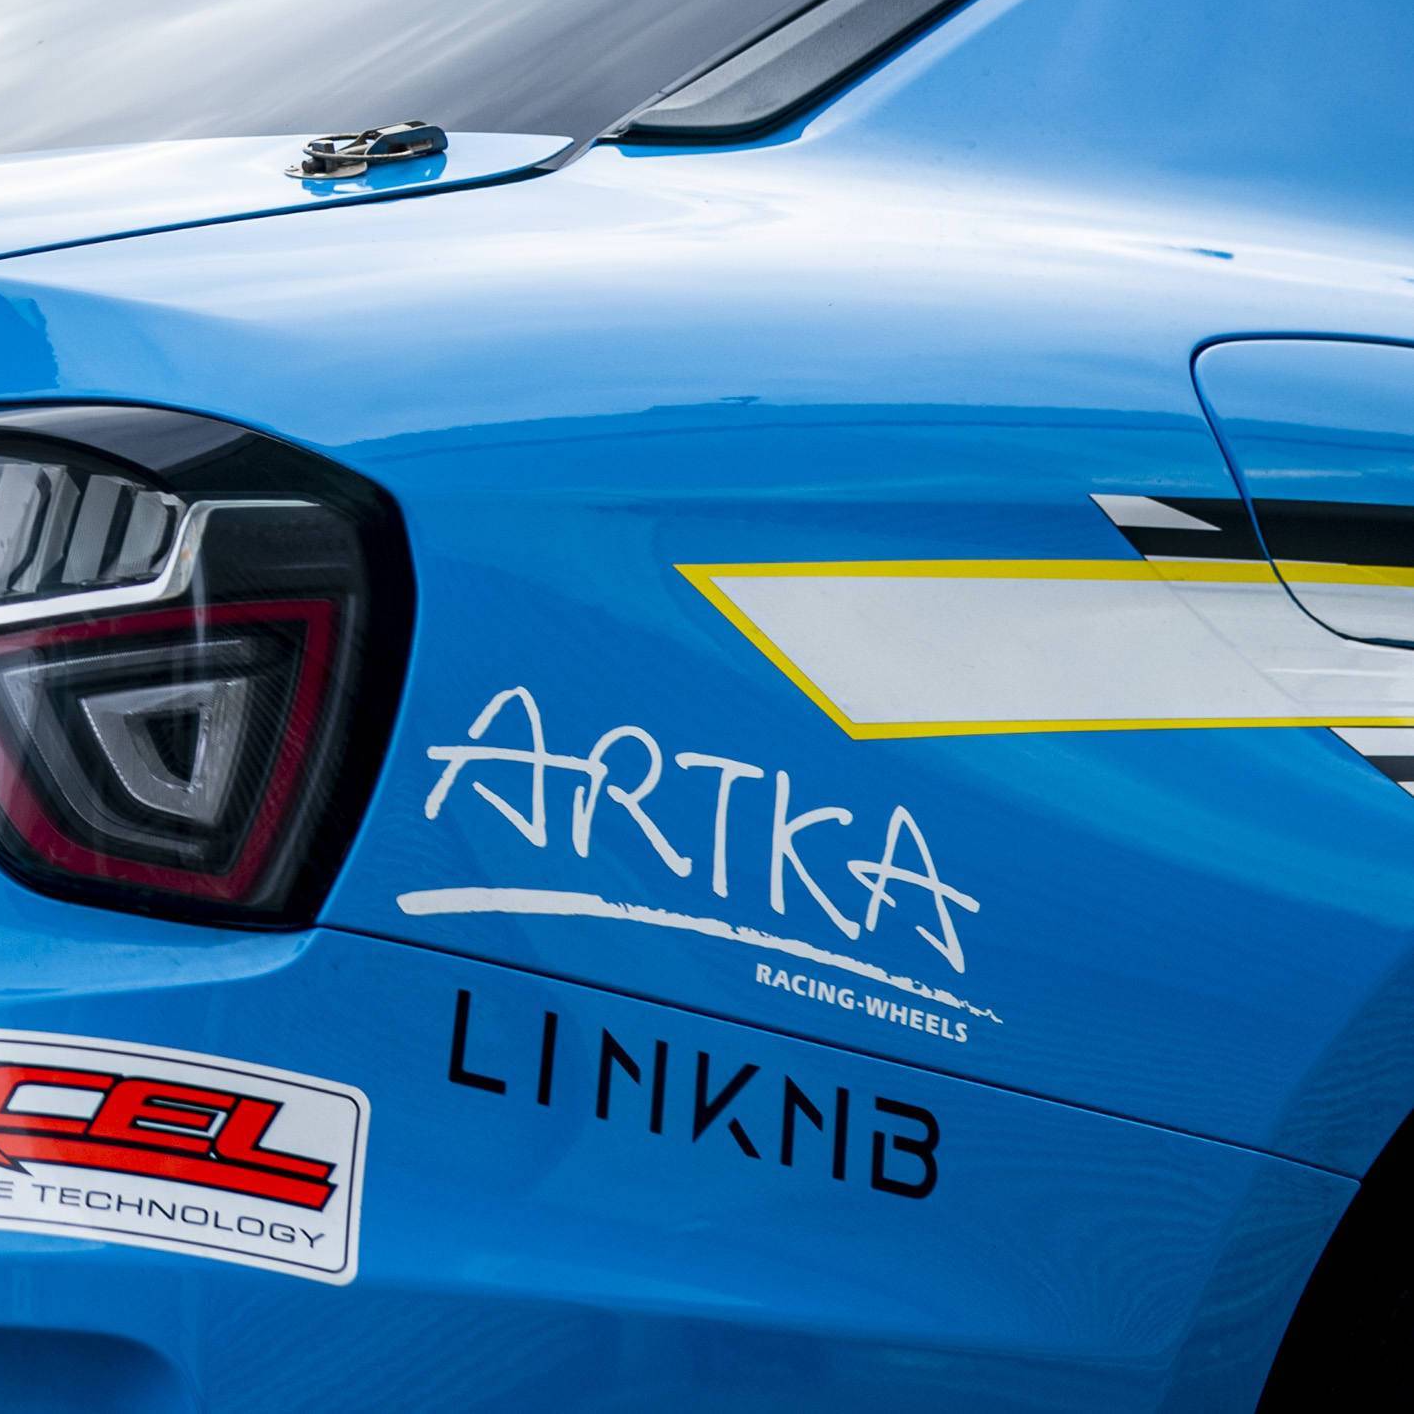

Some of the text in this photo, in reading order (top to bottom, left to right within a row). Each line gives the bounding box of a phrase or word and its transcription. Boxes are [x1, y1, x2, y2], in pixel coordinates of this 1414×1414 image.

[424, 686, 980, 973] ARTKA
[755, 963, 968, 1043] RACING-WHEELS
[448, 989, 940, 1199] LINKNB
[32, 1184, 325, 1250] TECHNOLOGY
